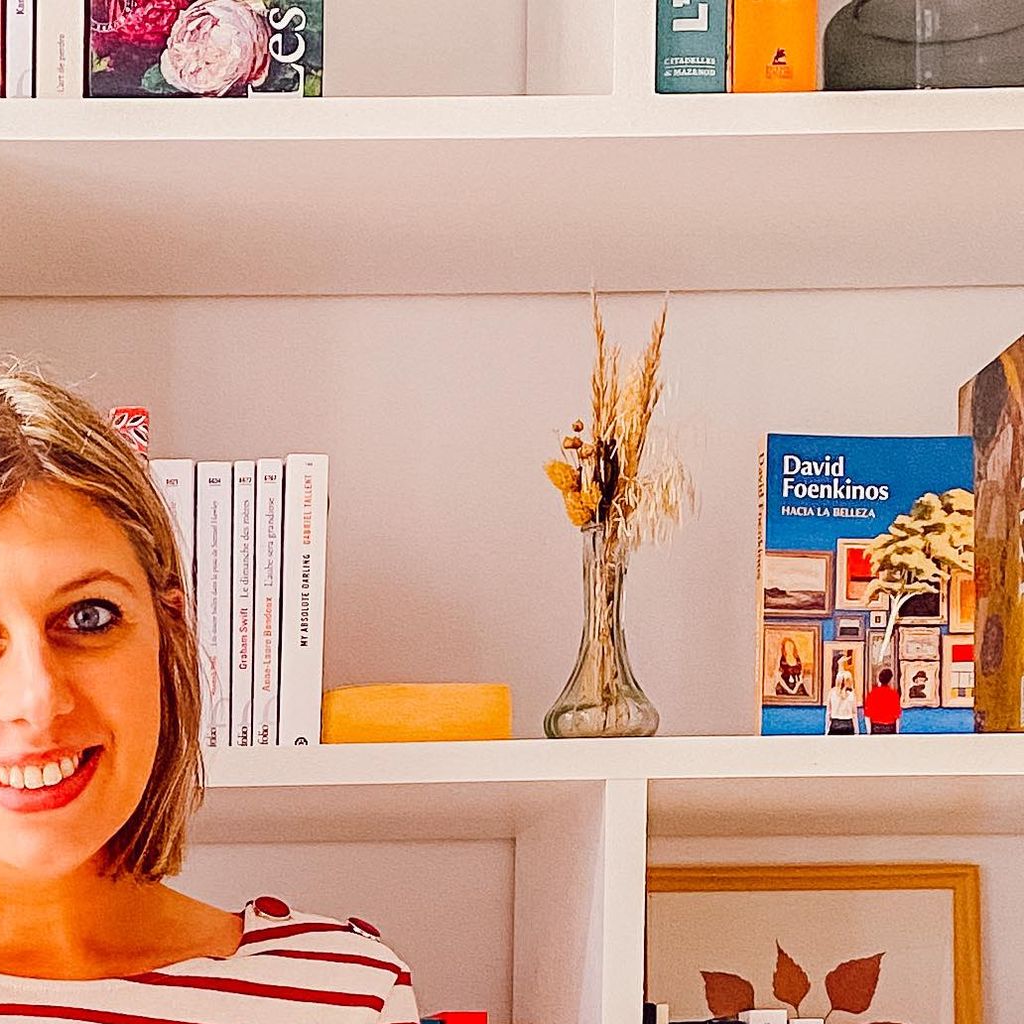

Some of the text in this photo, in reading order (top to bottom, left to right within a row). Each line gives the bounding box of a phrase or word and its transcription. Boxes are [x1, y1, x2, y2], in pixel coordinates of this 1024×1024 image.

[248, 6, 307, 97] Les
[664, 57, 716, 65] CITADELLES
[783, 455, 844, 476] David
[782, 478, 889, 500] Foenkinos
[303, 475, 312, 544] GABRIEL TALLENT
[782, 506, 875, 518] HACIA LA BELLEZA
[240, 544, 249, 598] Le dimanche
[300, 554, 310, 646] MY ABSOLUTE DARLING
[239, 608, 248, 669] Graham Swift
[259, 725, 268, 744] folio
